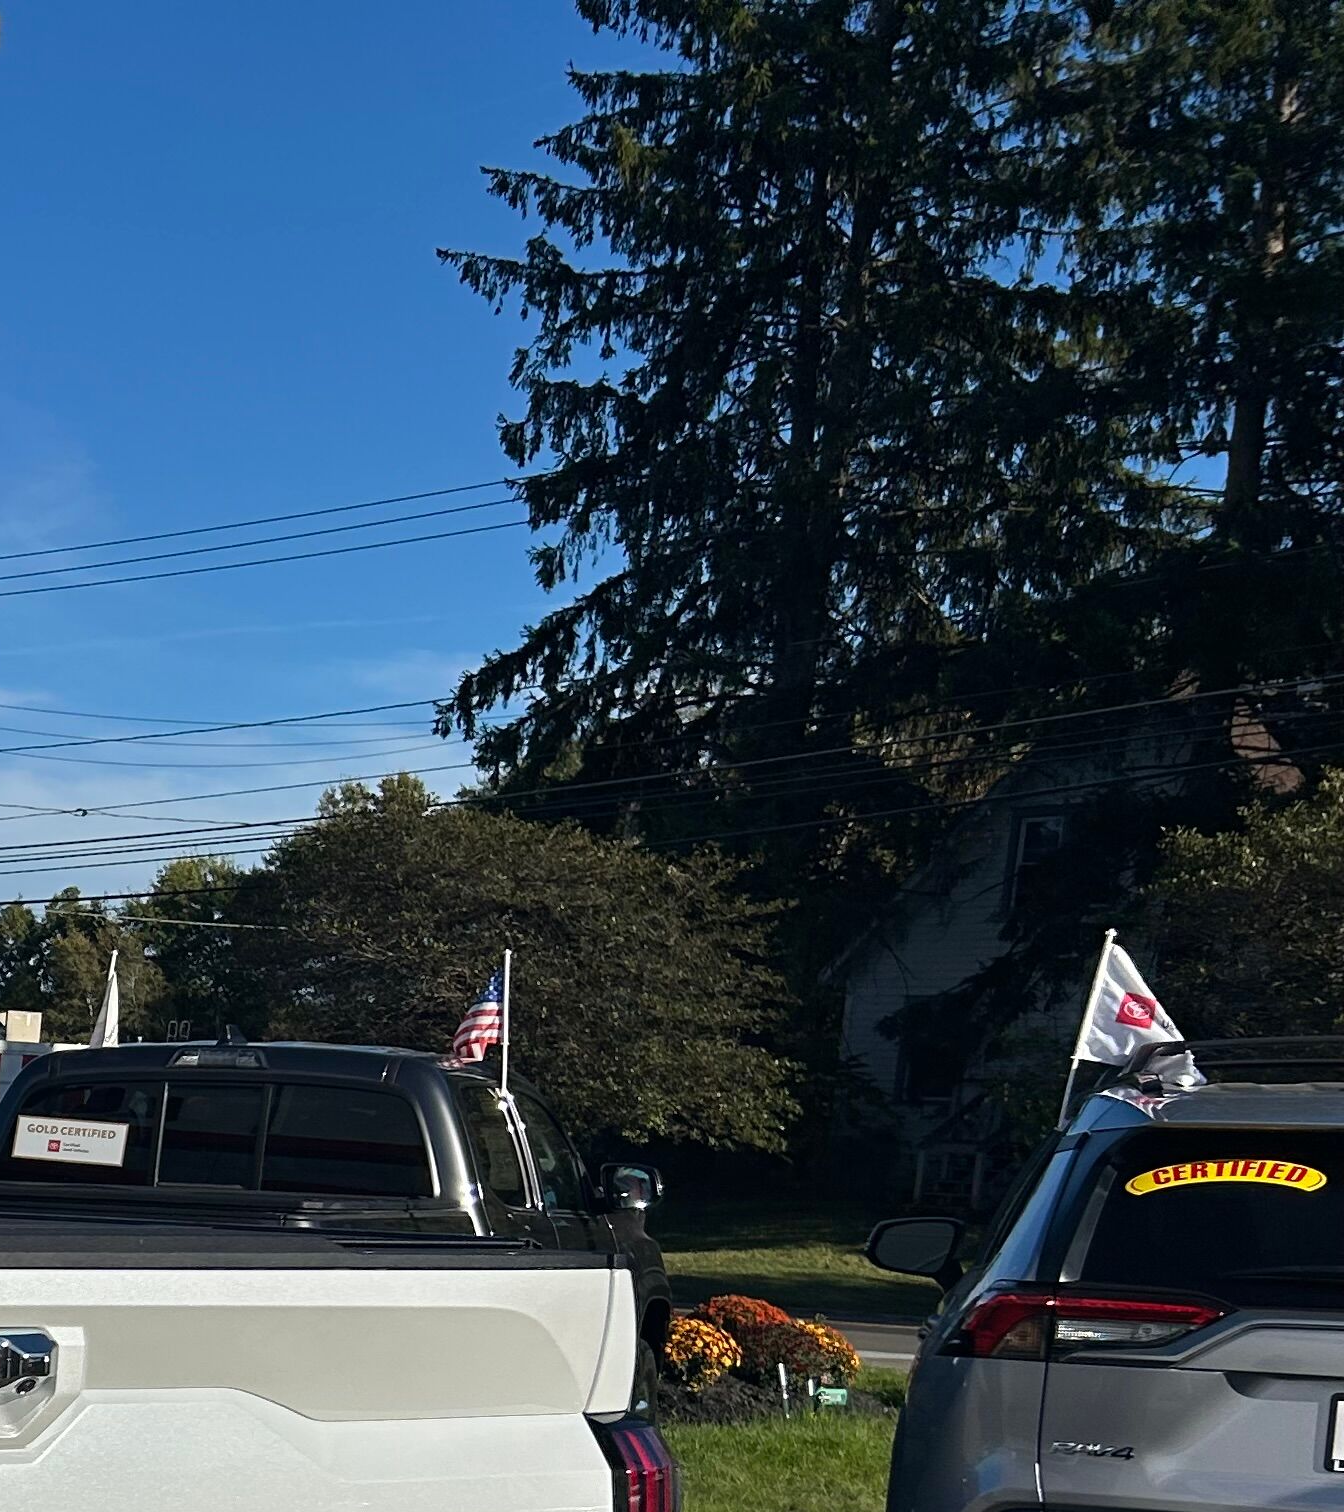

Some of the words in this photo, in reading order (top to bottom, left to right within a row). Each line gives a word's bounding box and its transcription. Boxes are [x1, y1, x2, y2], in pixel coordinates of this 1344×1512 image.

[27, 1123, 59, 1135] GOLD
[1152, 1160, 1309, 1185] CERTIFIED
[1051, 1441, 1135, 1460] RAV4
